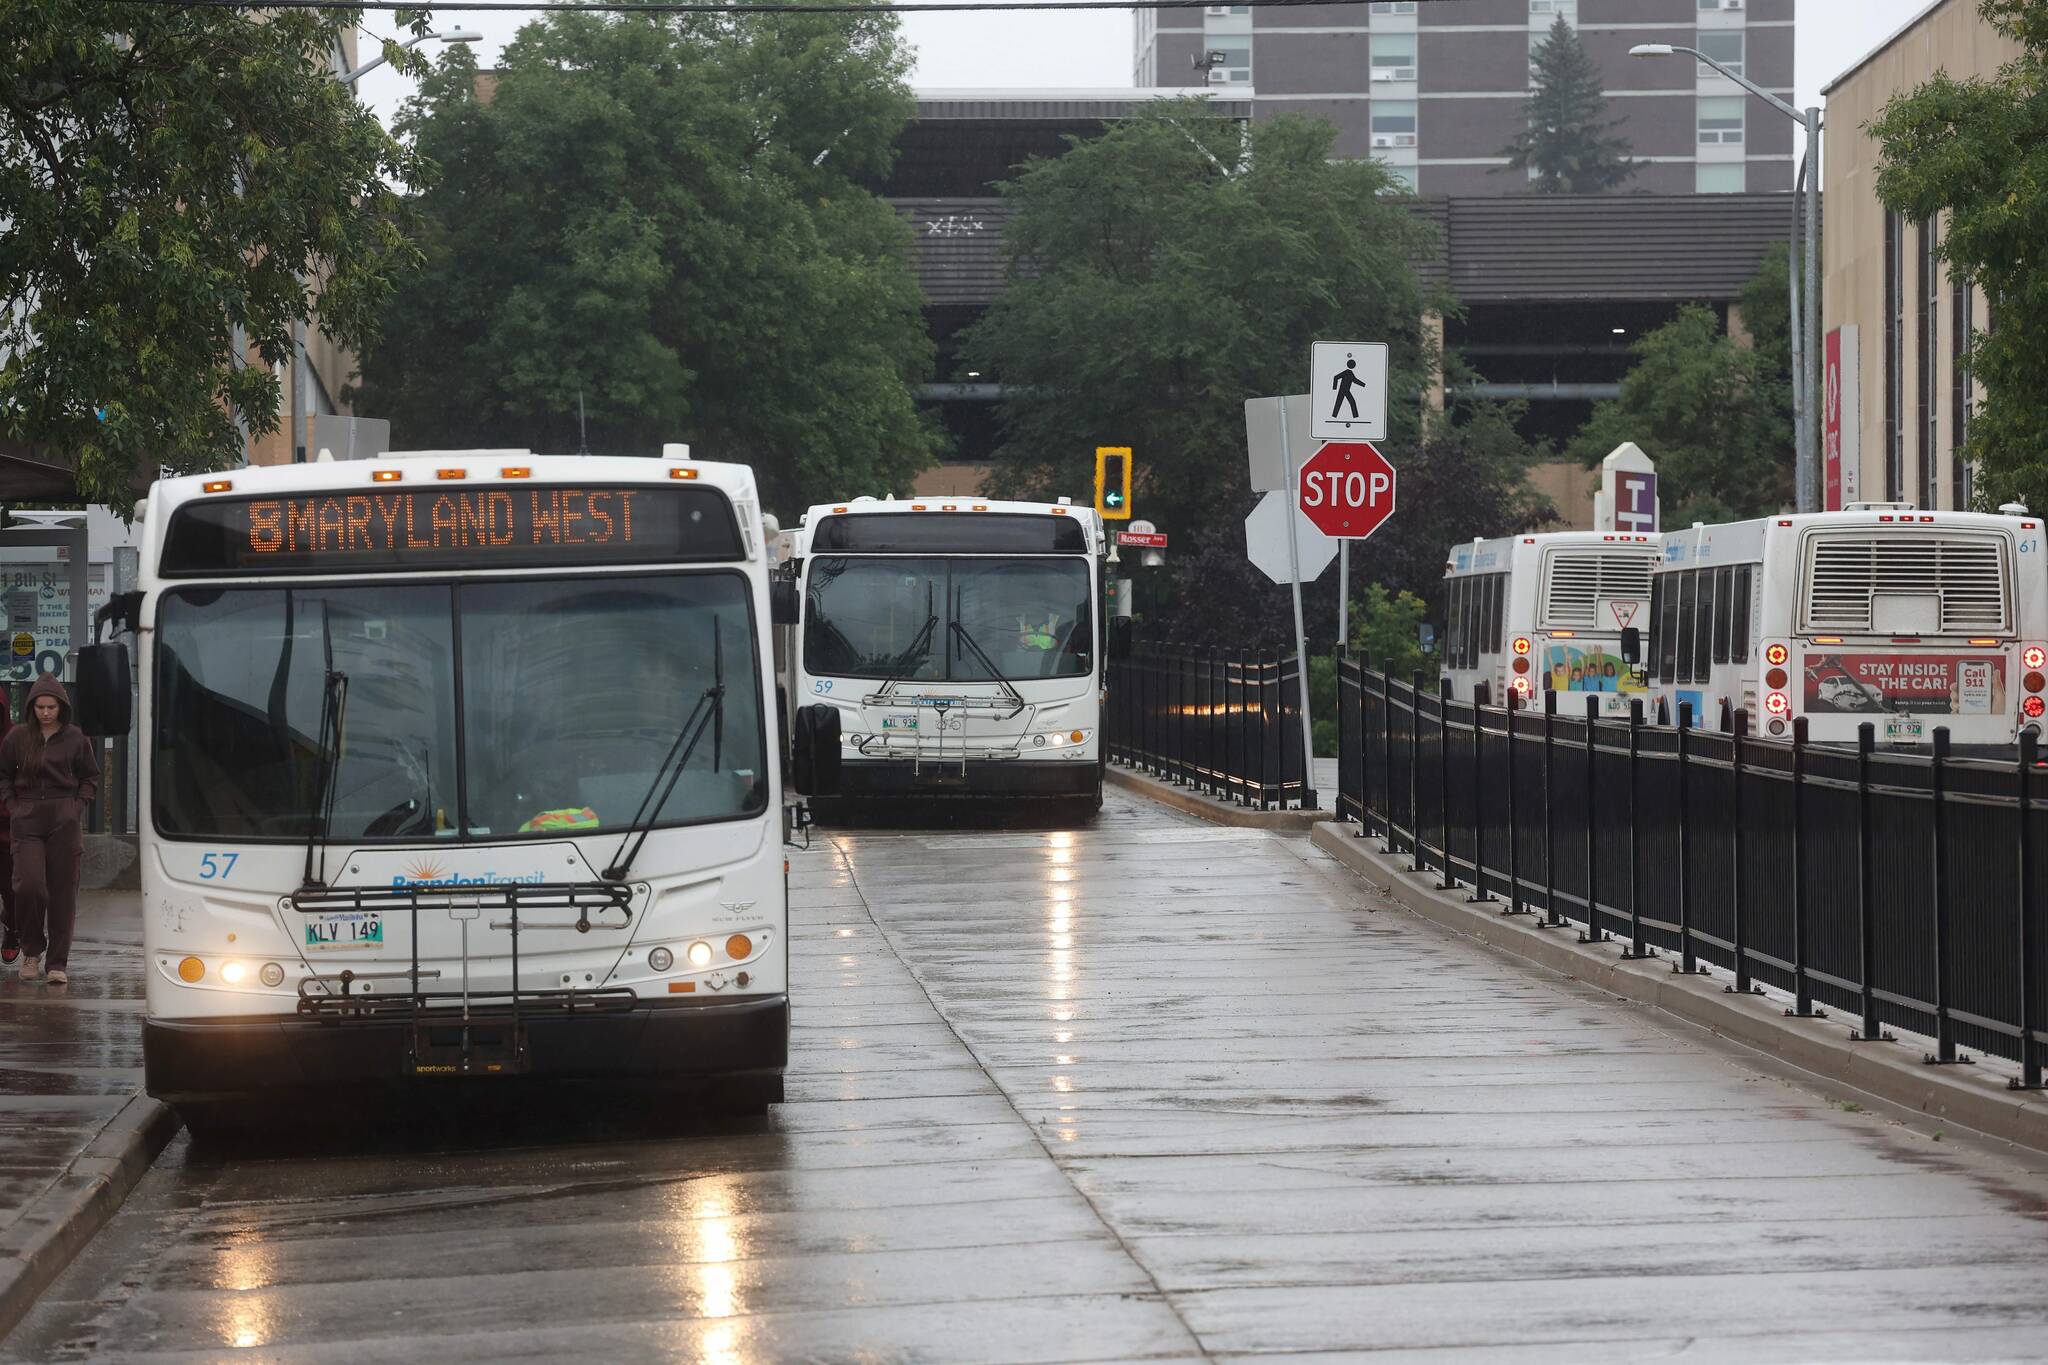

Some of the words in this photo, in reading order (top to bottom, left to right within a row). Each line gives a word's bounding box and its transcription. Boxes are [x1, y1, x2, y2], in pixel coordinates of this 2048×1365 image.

[1304, 471, 1390, 507] STOP
[288, 491, 513, 551] MARYLAND
[531, 490, 638, 544] WEST
[1121, 533, 1151, 543] Rosser
[2020, 539, 2037, 552] 61
[15, 572, 37, 587] 8th
[42, 571, 56, 587] St
[1859, 663, 1895, 676] STAY
[1899, 663, 1948, 676] INSIDE
[1964, 668, 1986, 678] Call
[815, 680, 833, 694] 59
[1879, 677, 1908, 690] THE
[1911, 677, 1948, 690] CAR!
[1965, 678, 1985, 688] 911
[200, 853, 240, 879] 57
[308, 922, 338, 942] KLV
[351, 921, 379, 940] 149
[416, 1064, 457, 1073] sportworks
